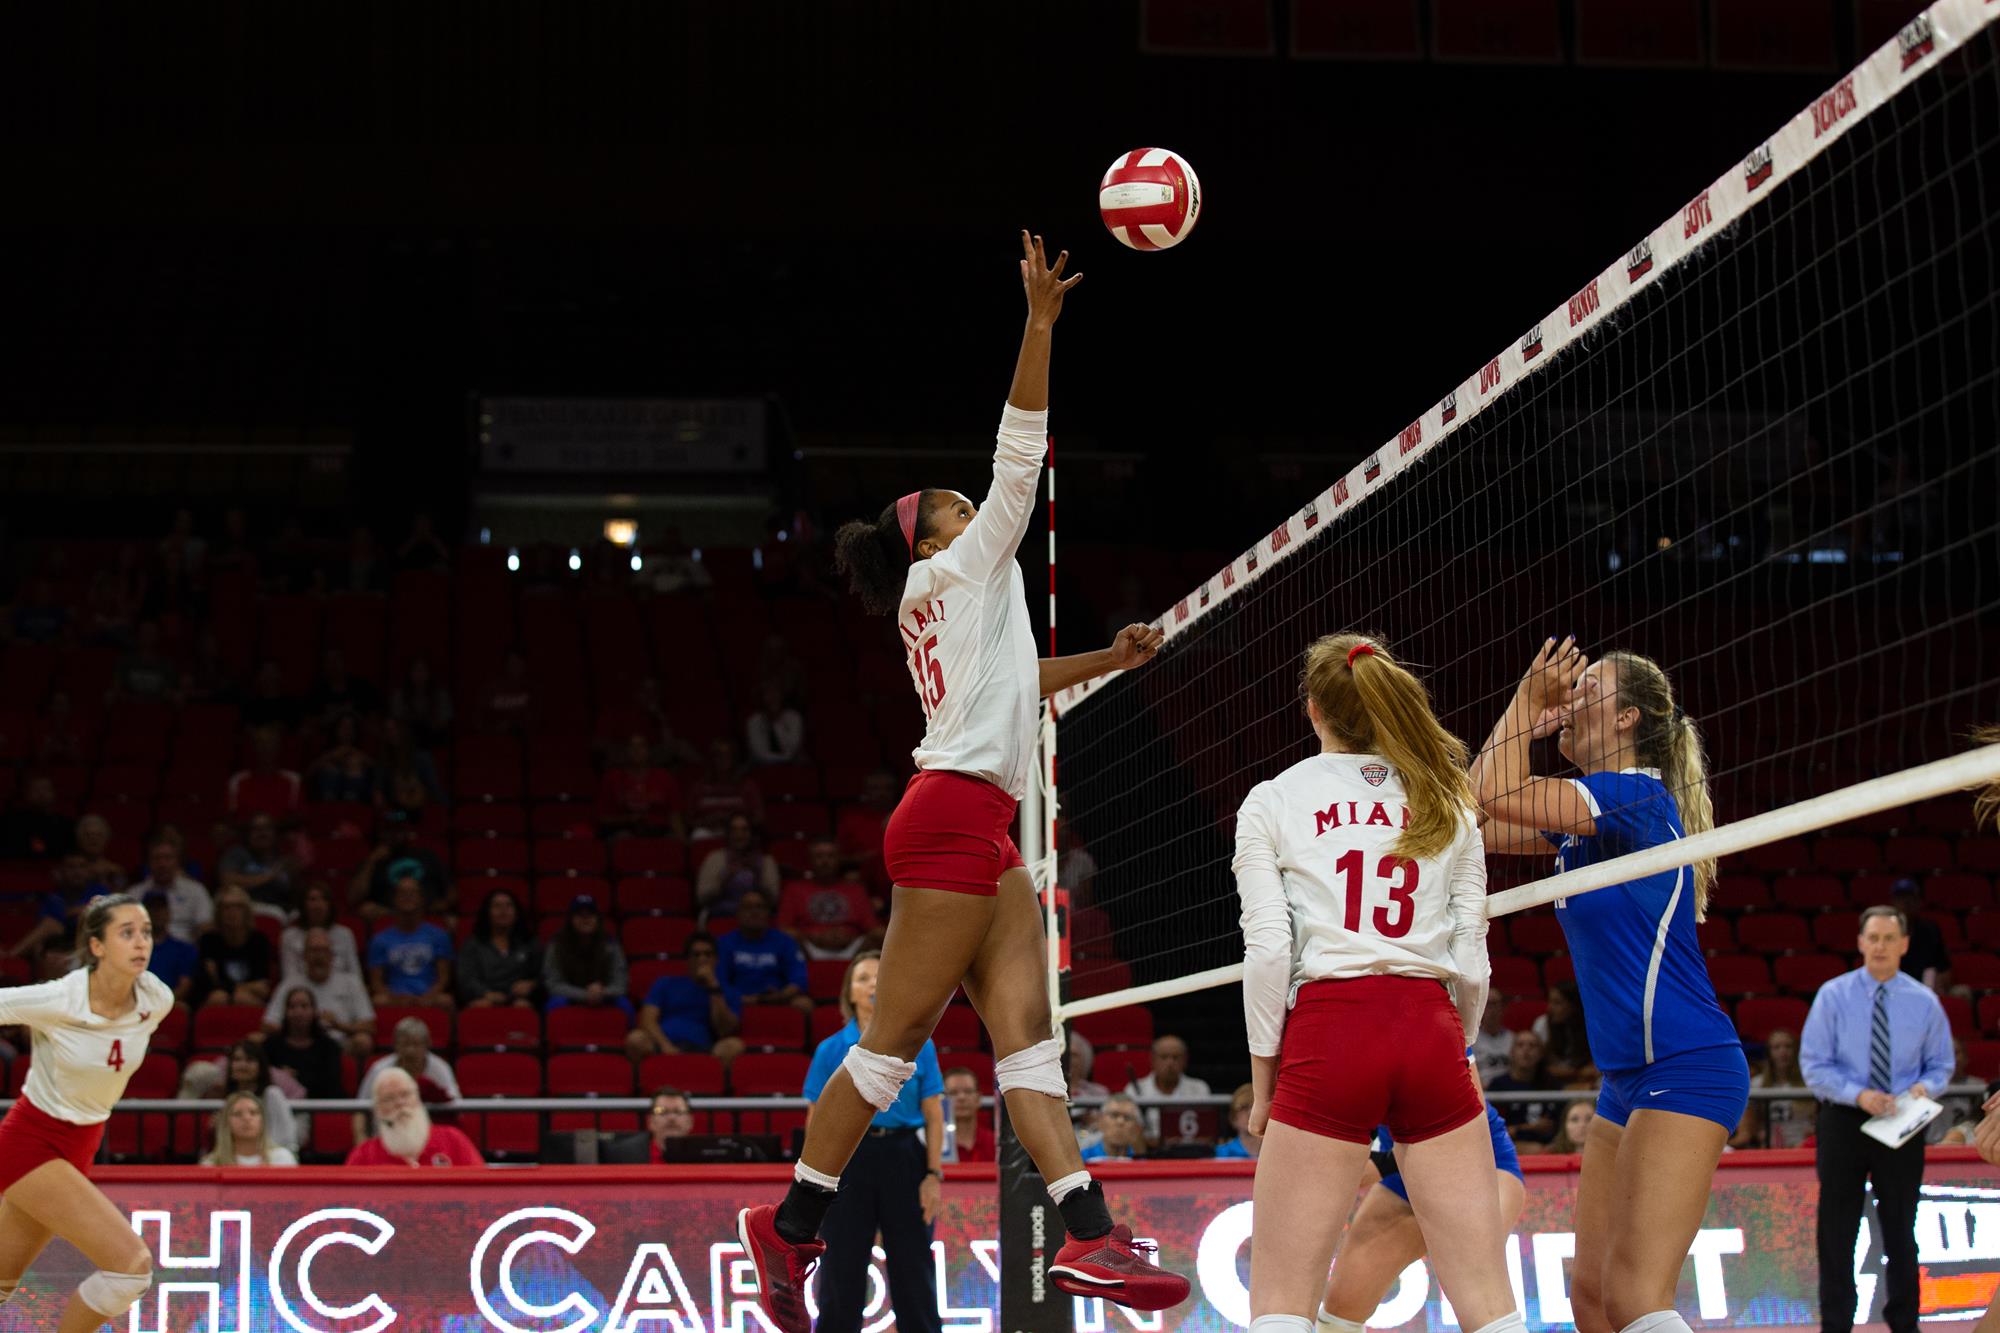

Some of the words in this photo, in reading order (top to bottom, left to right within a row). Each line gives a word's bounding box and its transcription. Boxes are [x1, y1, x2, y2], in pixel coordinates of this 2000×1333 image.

[1313, 801, 1412, 838] MIA
[1335, 849, 1420, 939] 13
[107, 1039, 125, 1073] 4
[1179, 1110, 1200, 1136] 6
[130, 1208, 397, 1333] HC
